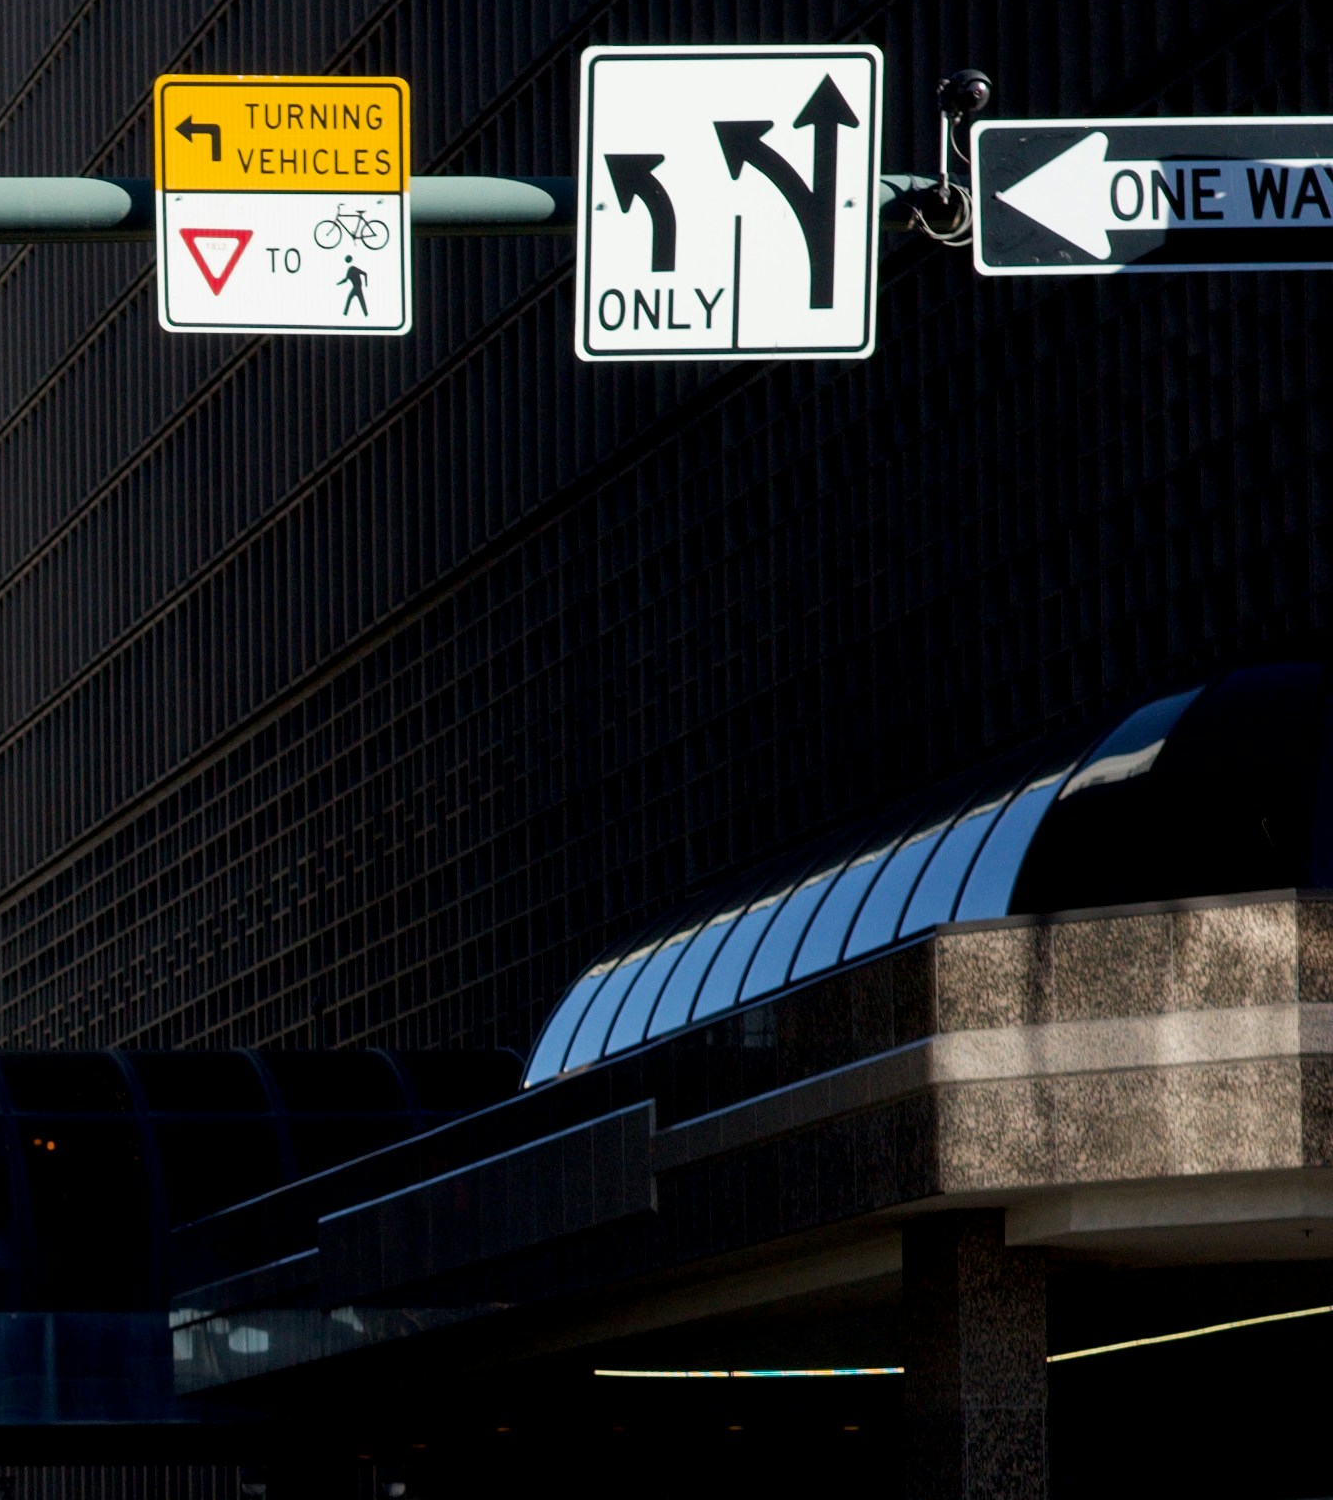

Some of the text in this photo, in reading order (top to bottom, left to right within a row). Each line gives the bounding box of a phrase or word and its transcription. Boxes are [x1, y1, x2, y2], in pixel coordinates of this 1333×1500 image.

[244, 102, 384, 134] TURNING
[237, 144, 393, 177] VEHICLES
[1110, 167, 1333, 222] ONE WA
[265, 247, 302, 274] TO
[598, 288, 725, 332] ONLY
